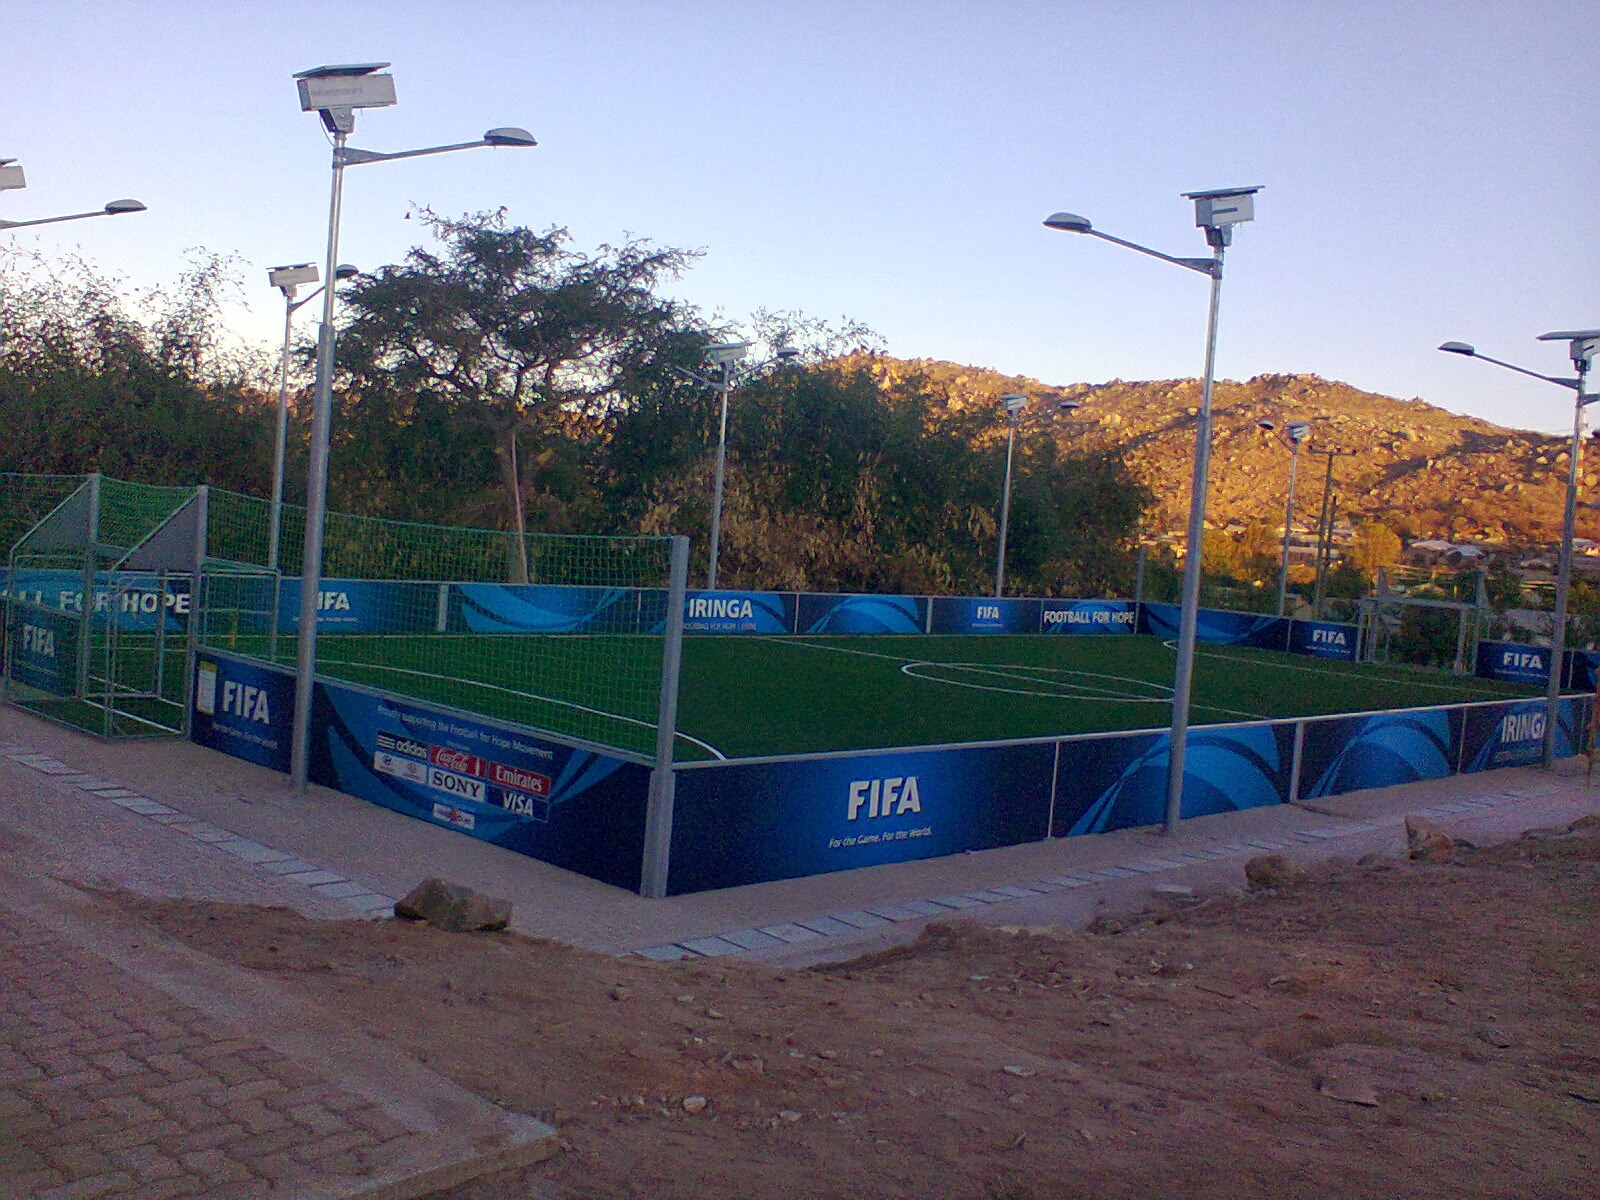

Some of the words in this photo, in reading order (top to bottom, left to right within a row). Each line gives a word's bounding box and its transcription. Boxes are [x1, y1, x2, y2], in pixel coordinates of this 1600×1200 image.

[122, 593, 191, 615] HOPE
[316, 591, 351, 611] IFA
[688, 598, 754, 619] IRINGA
[977, 605, 1000, 619] FIFA
[1044, 610, 1090, 623] FOOTBALL
[1092, 610, 1108, 624] FOR
[1111, 611, 1135, 624] HOPE
[1313, 629, 1347, 646] FIFA
[1503, 651, 1543, 670] FIFA
[222, 680, 270, 725] FIFA
[396, 740, 429, 760] adidas
[433, 771, 480, 799] SONY
[495, 764, 543, 793] Emirates
[502, 791, 534, 817] VISA
[847, 776, 921, 820] FIFA
